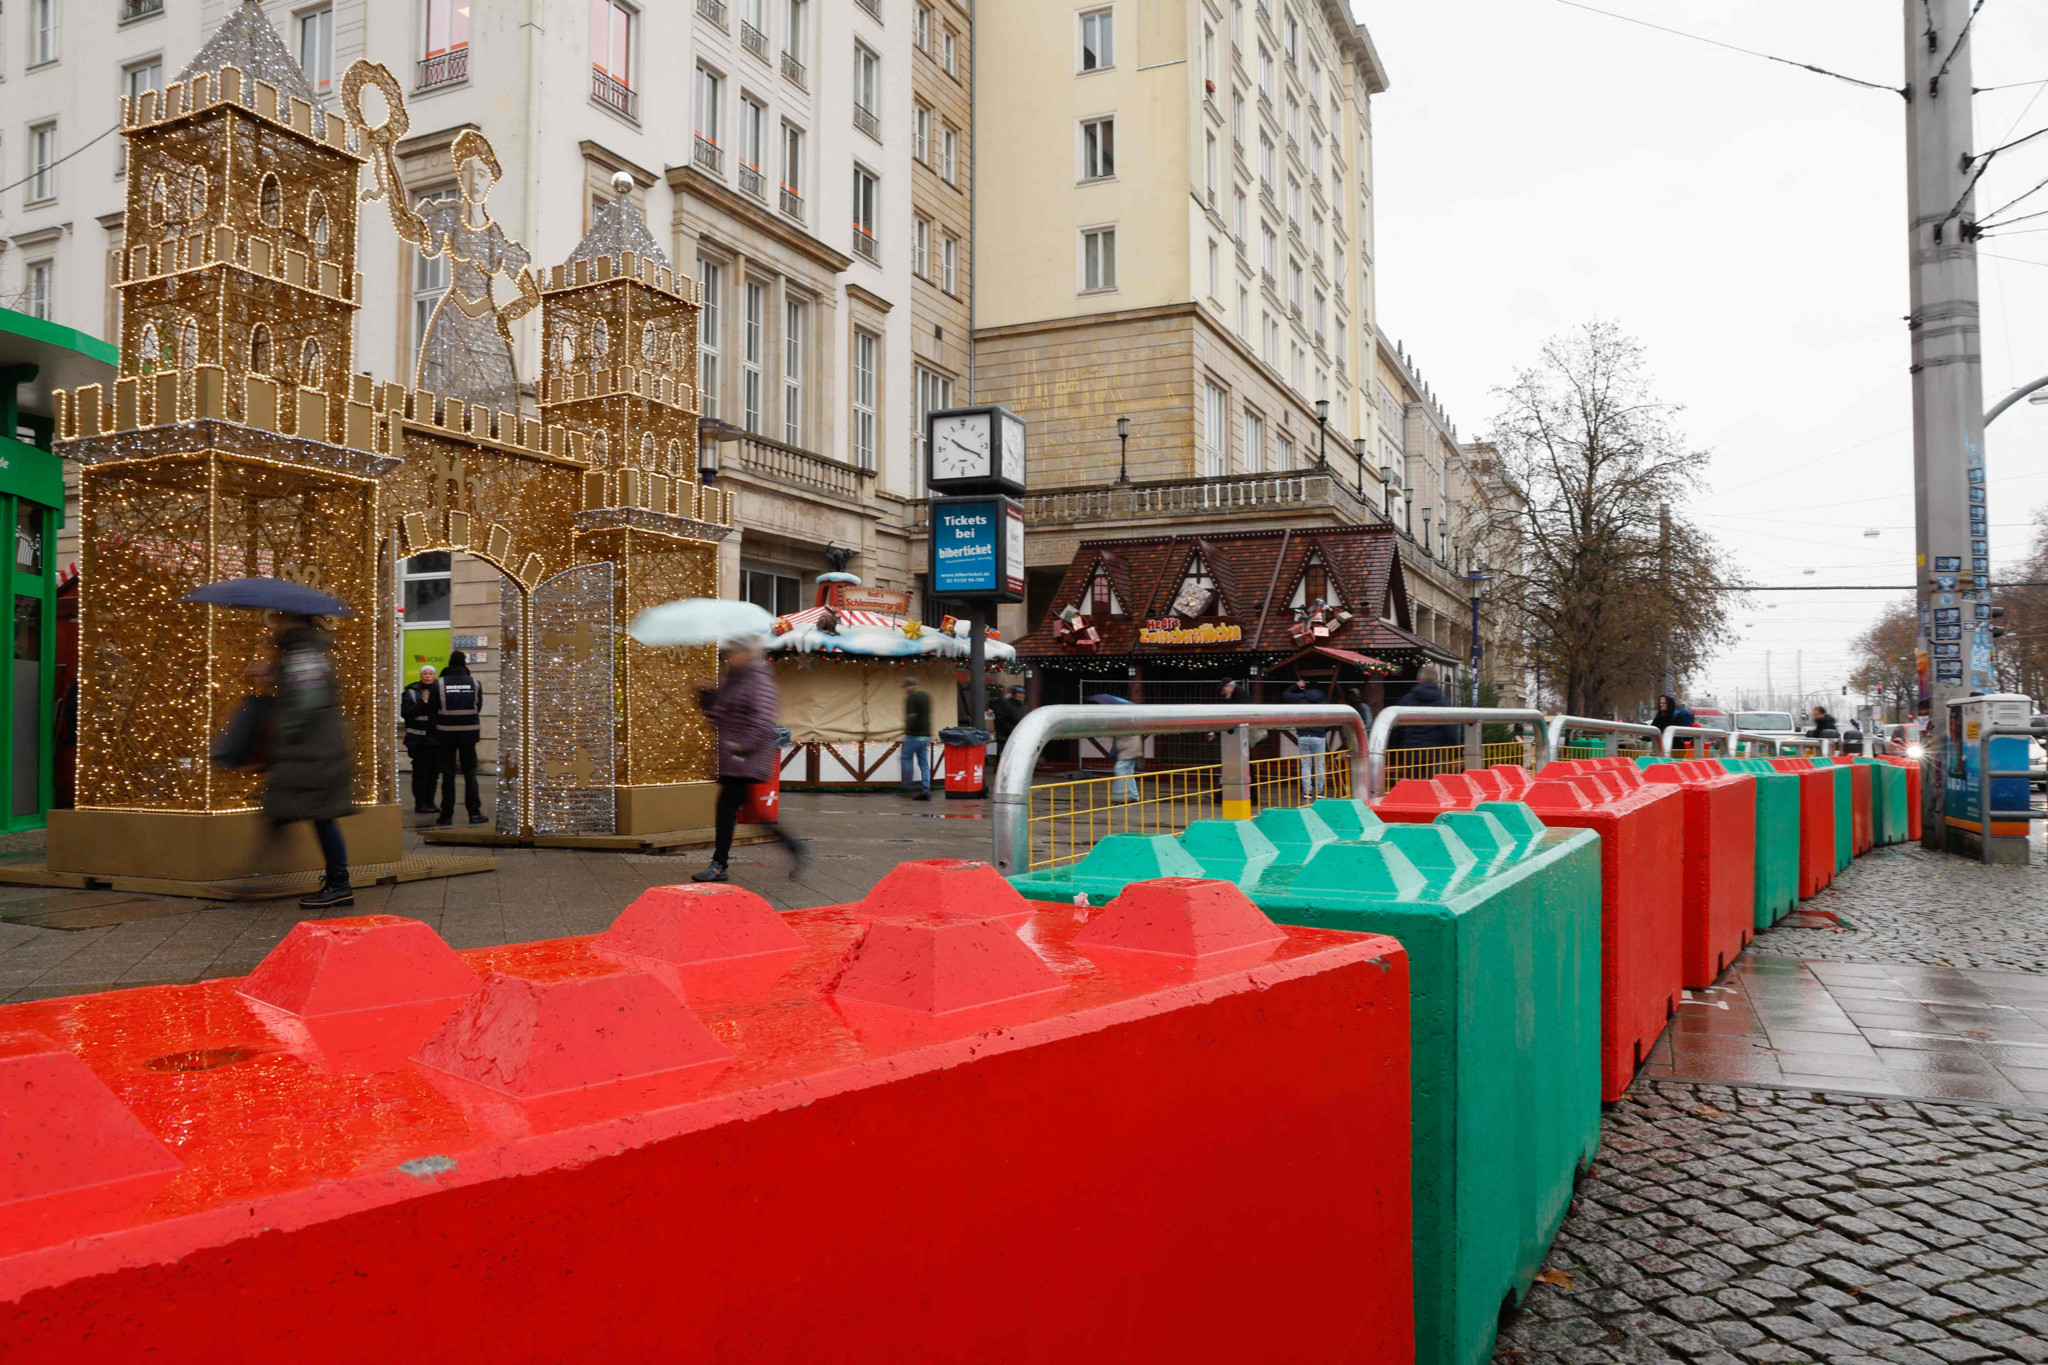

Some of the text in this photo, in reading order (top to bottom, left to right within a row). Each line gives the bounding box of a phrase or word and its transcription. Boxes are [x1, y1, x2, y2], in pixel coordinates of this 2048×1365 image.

[944, 515, 987, 526] Tickets
[955, 528, 975, 539] bei
[939, 543, 992, 558] biberticket
[846, 598, 903, 611] Schlemmergrill
[1139, 622, 1242, 644] Zwitscherstübchen
